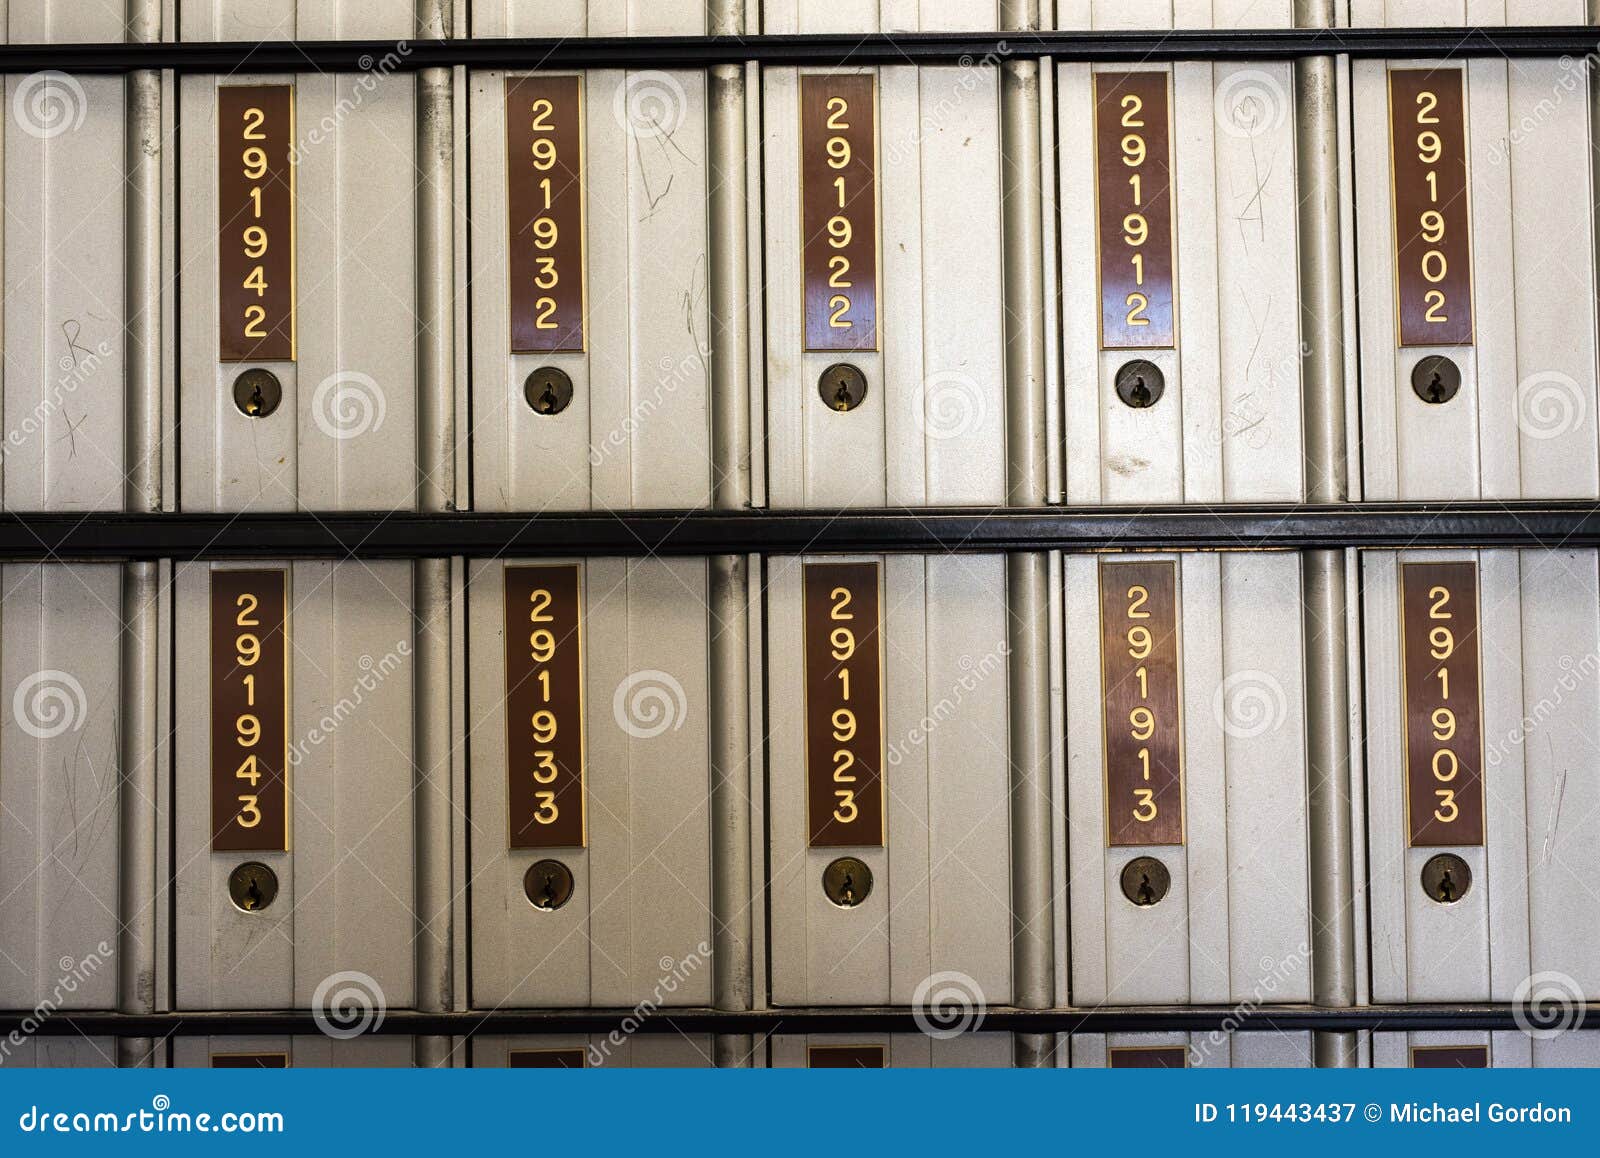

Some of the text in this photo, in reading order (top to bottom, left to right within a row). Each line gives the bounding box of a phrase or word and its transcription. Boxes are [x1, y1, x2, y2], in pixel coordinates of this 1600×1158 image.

[242, 108, 268, 337] 291942
[532, 99, 558, 329] 291932
[826, 97, 852, 328] 291922
[1121, 94, 1149, 326] 291912
[1416, 91, 1448, 323] 291902
[236, 593, 261, 828] 291943
[530, 589, 559, 824] 291933
[830, 587, 858, 823] 291923
[1127, 585, 1157, 822] 291913
[1429, 586, 1459, 823] 291903
